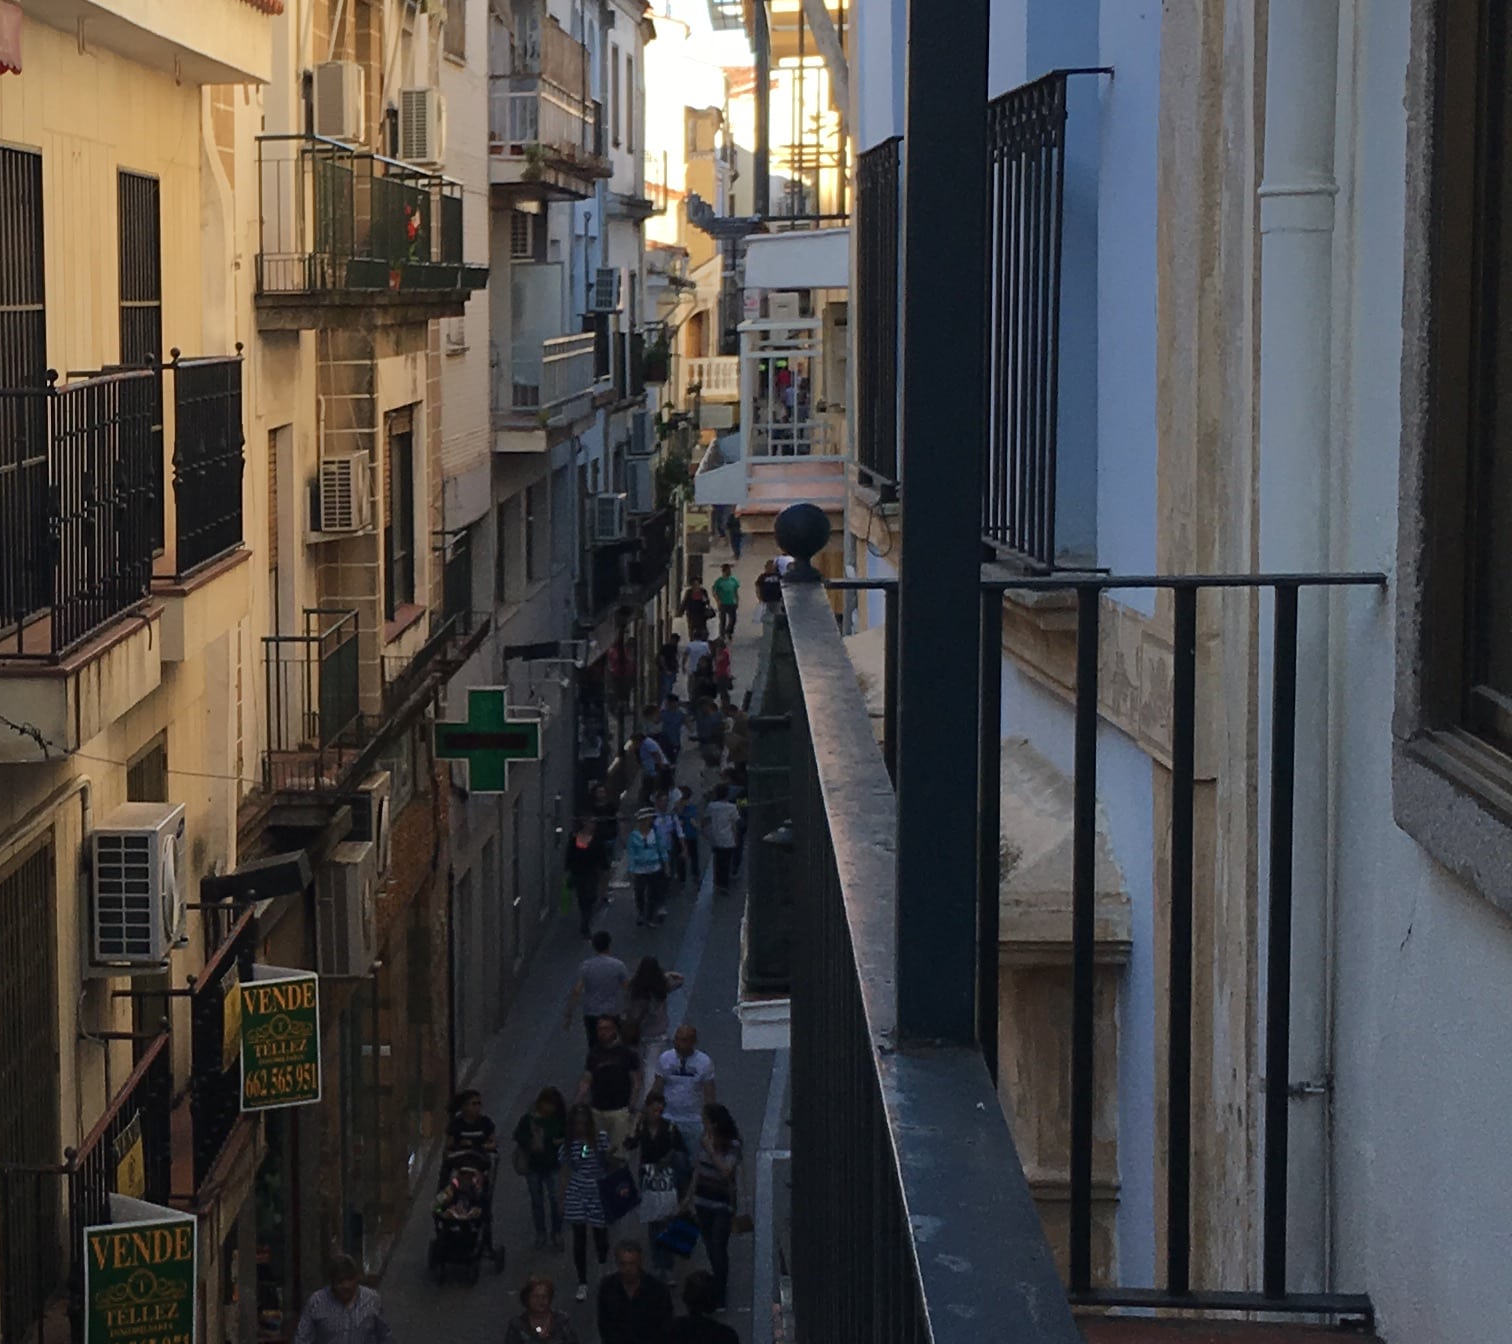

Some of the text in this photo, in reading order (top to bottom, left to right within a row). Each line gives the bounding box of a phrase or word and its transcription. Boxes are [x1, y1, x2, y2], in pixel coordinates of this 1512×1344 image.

[243, 981, 316, 1016] VENDE
[245, 1061, 318, 1097] 662 565 951
[90, 1226, 192, 1271] VENDE
